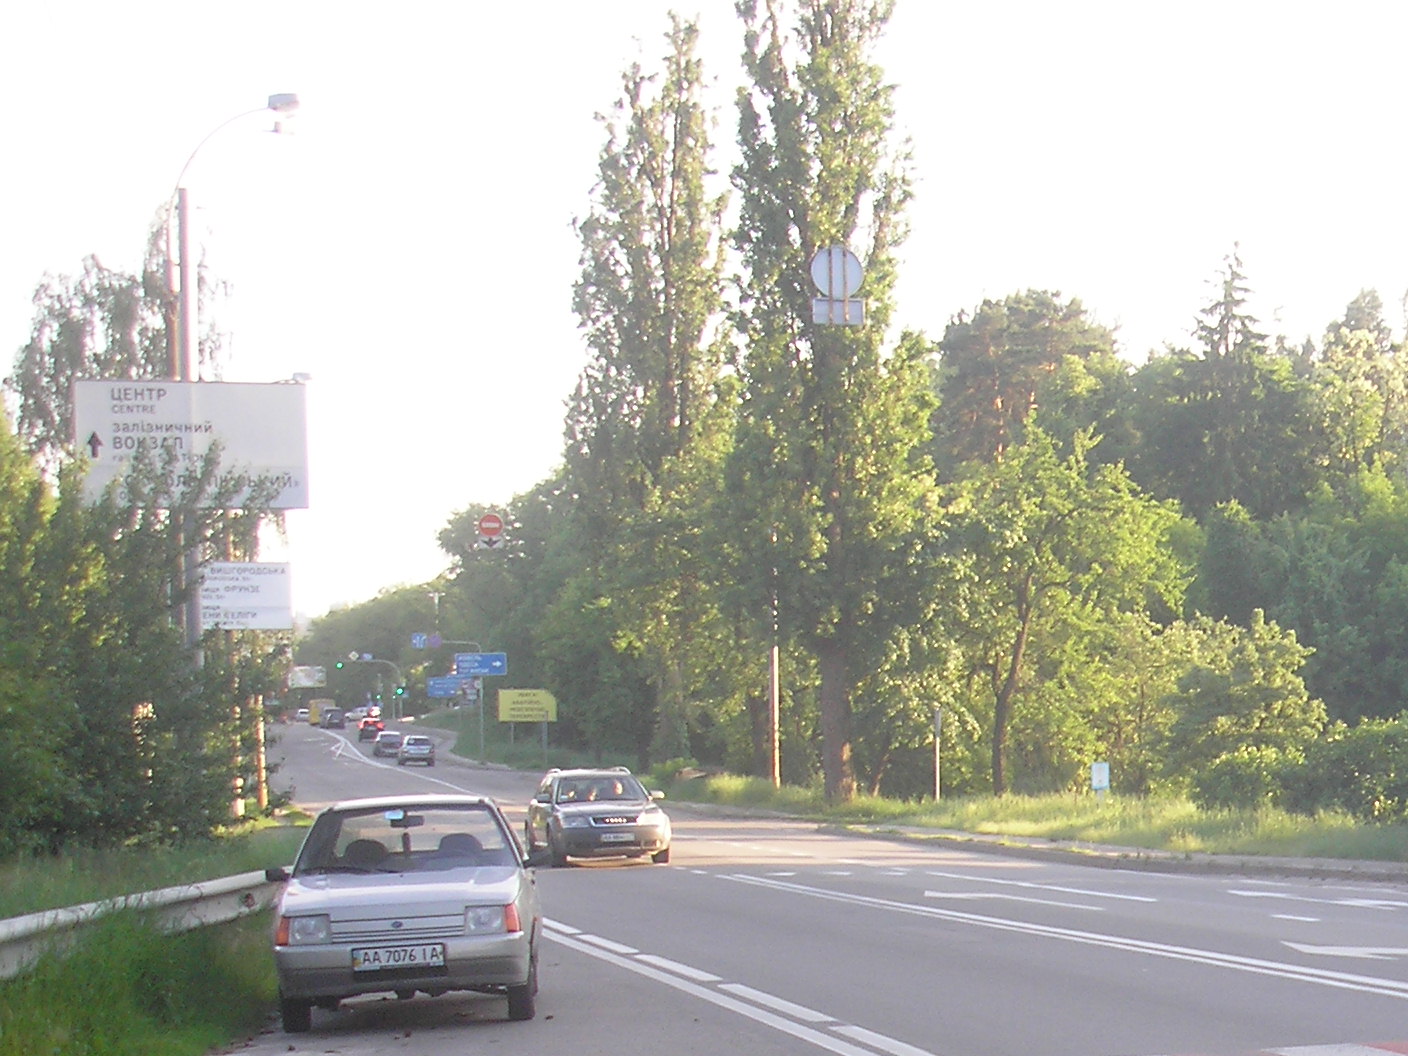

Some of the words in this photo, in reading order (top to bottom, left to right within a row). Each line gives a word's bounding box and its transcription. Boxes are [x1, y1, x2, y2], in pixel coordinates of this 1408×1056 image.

[110, 387, 167, 402] ЦЕНТР
[111, 404, 156, 414] CENTRE
[112, 420, 213, 433] залізничний
[112, 436, 183, 450] ВОКЗАЛ
[363, 951, 382, 964] AA
[385, 948, 417, 963] 7076
